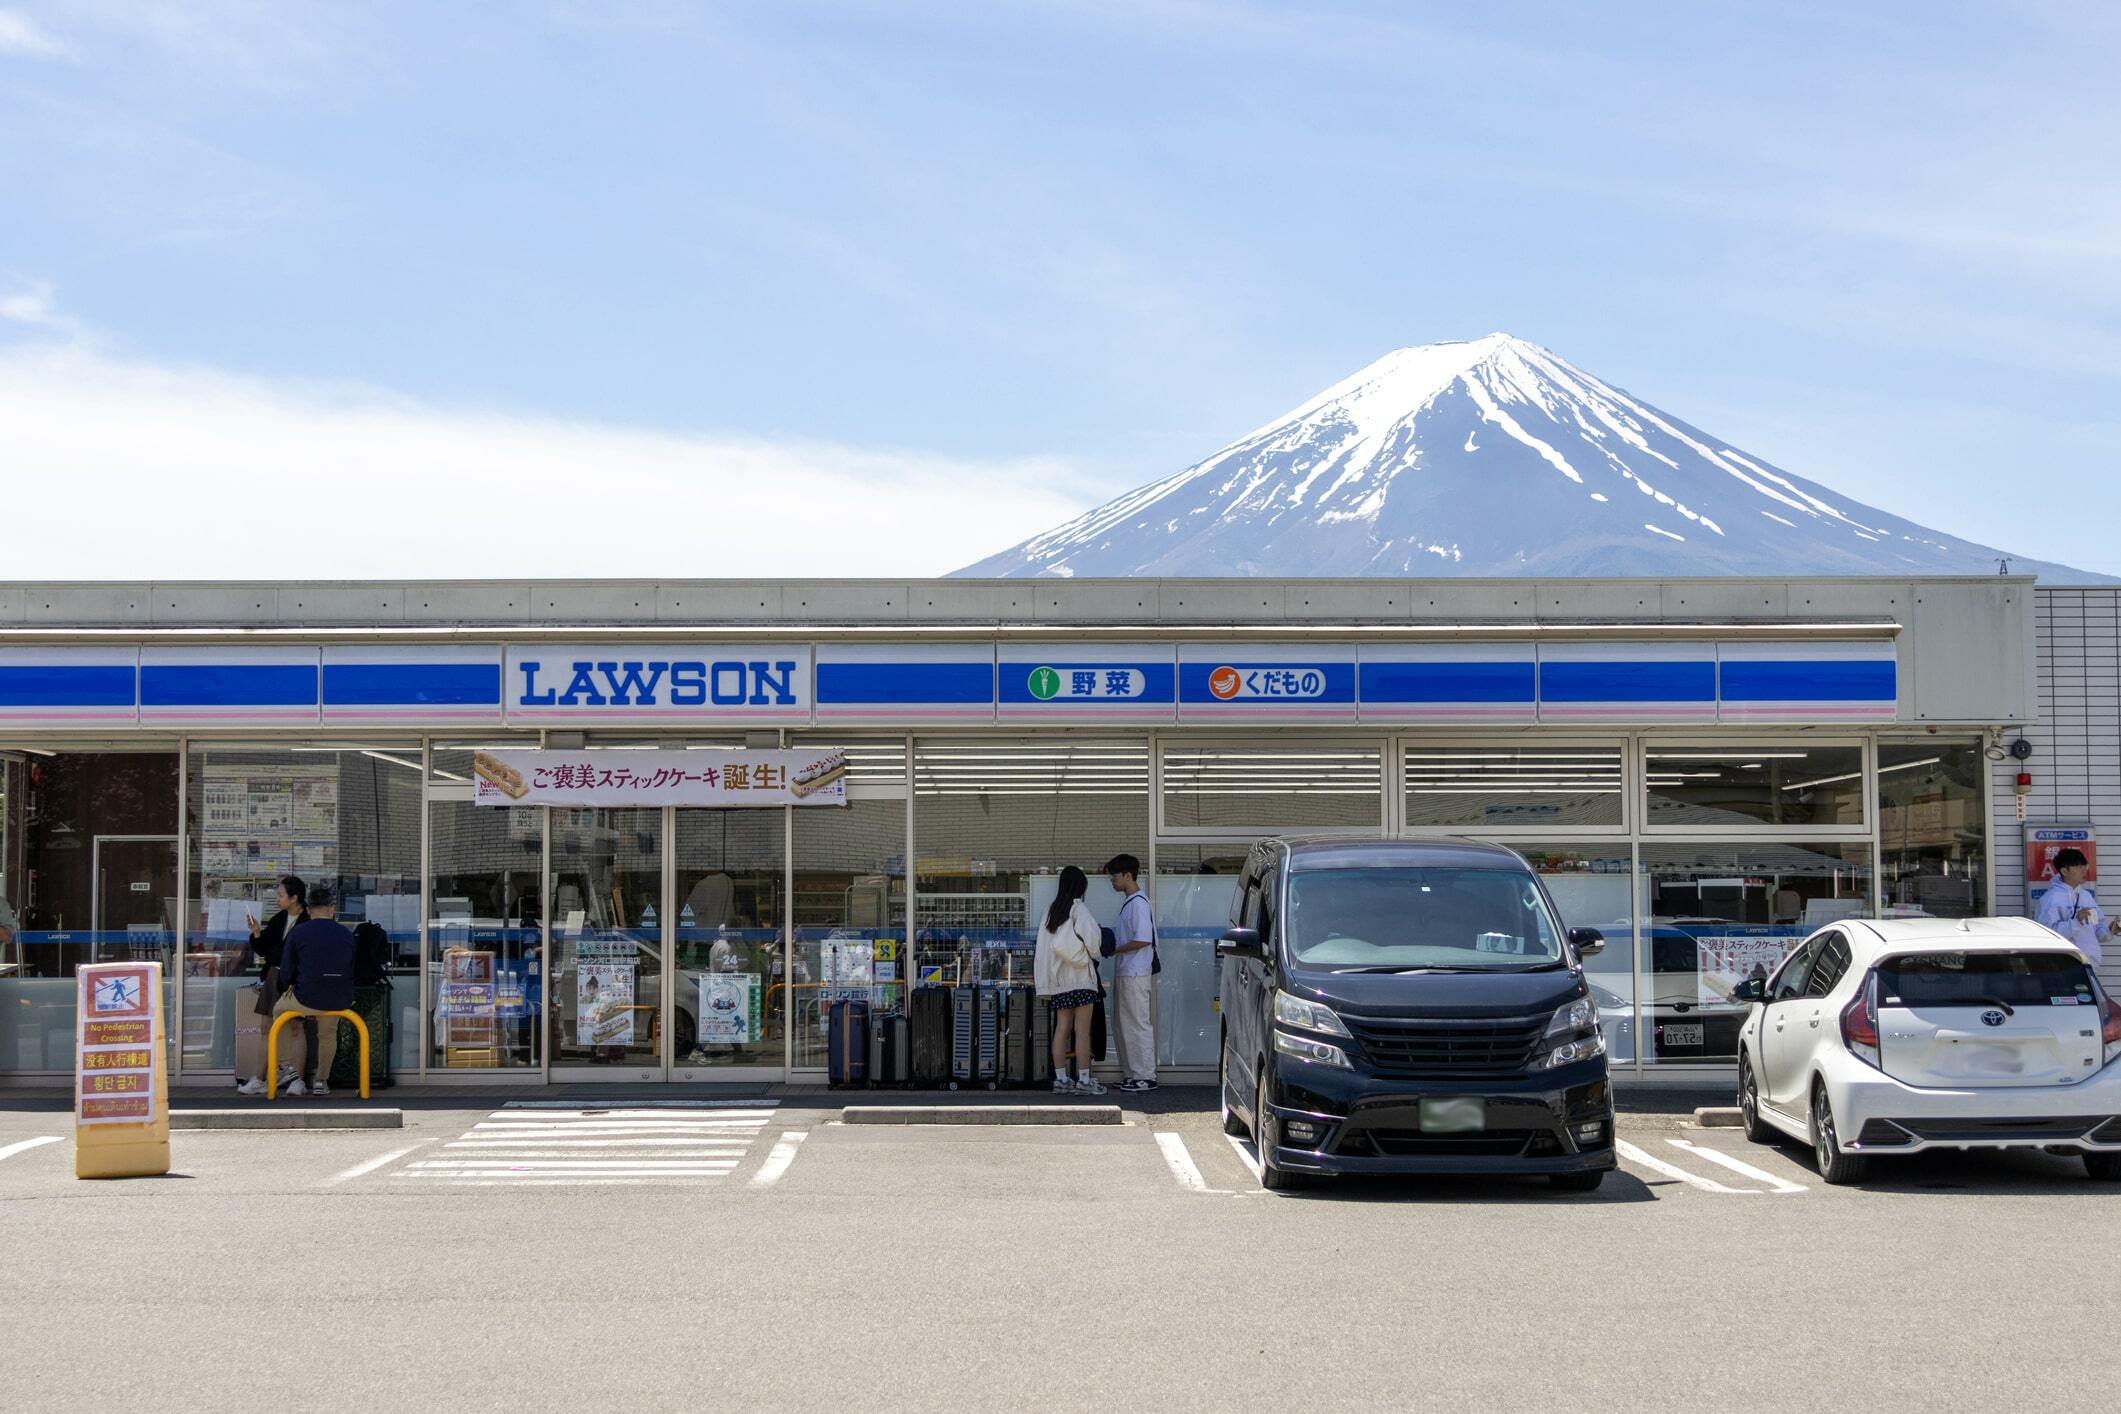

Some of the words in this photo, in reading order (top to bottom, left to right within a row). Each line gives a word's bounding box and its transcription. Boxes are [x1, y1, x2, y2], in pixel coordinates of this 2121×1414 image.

[520, 661, 796, 705] LAWSON
[1071, 671, 1131, 696] 野菜
[1246, 671, 1320, 696] くだもの
[2038, 831, 2086, 839] ATMサービス
[723, 955, 737, 965] 24
[90, 1024, 102, 1032] No
[103, 1022, 144, 1031] Pedestrian
[101, 1034, 134, 1043] Crossing
